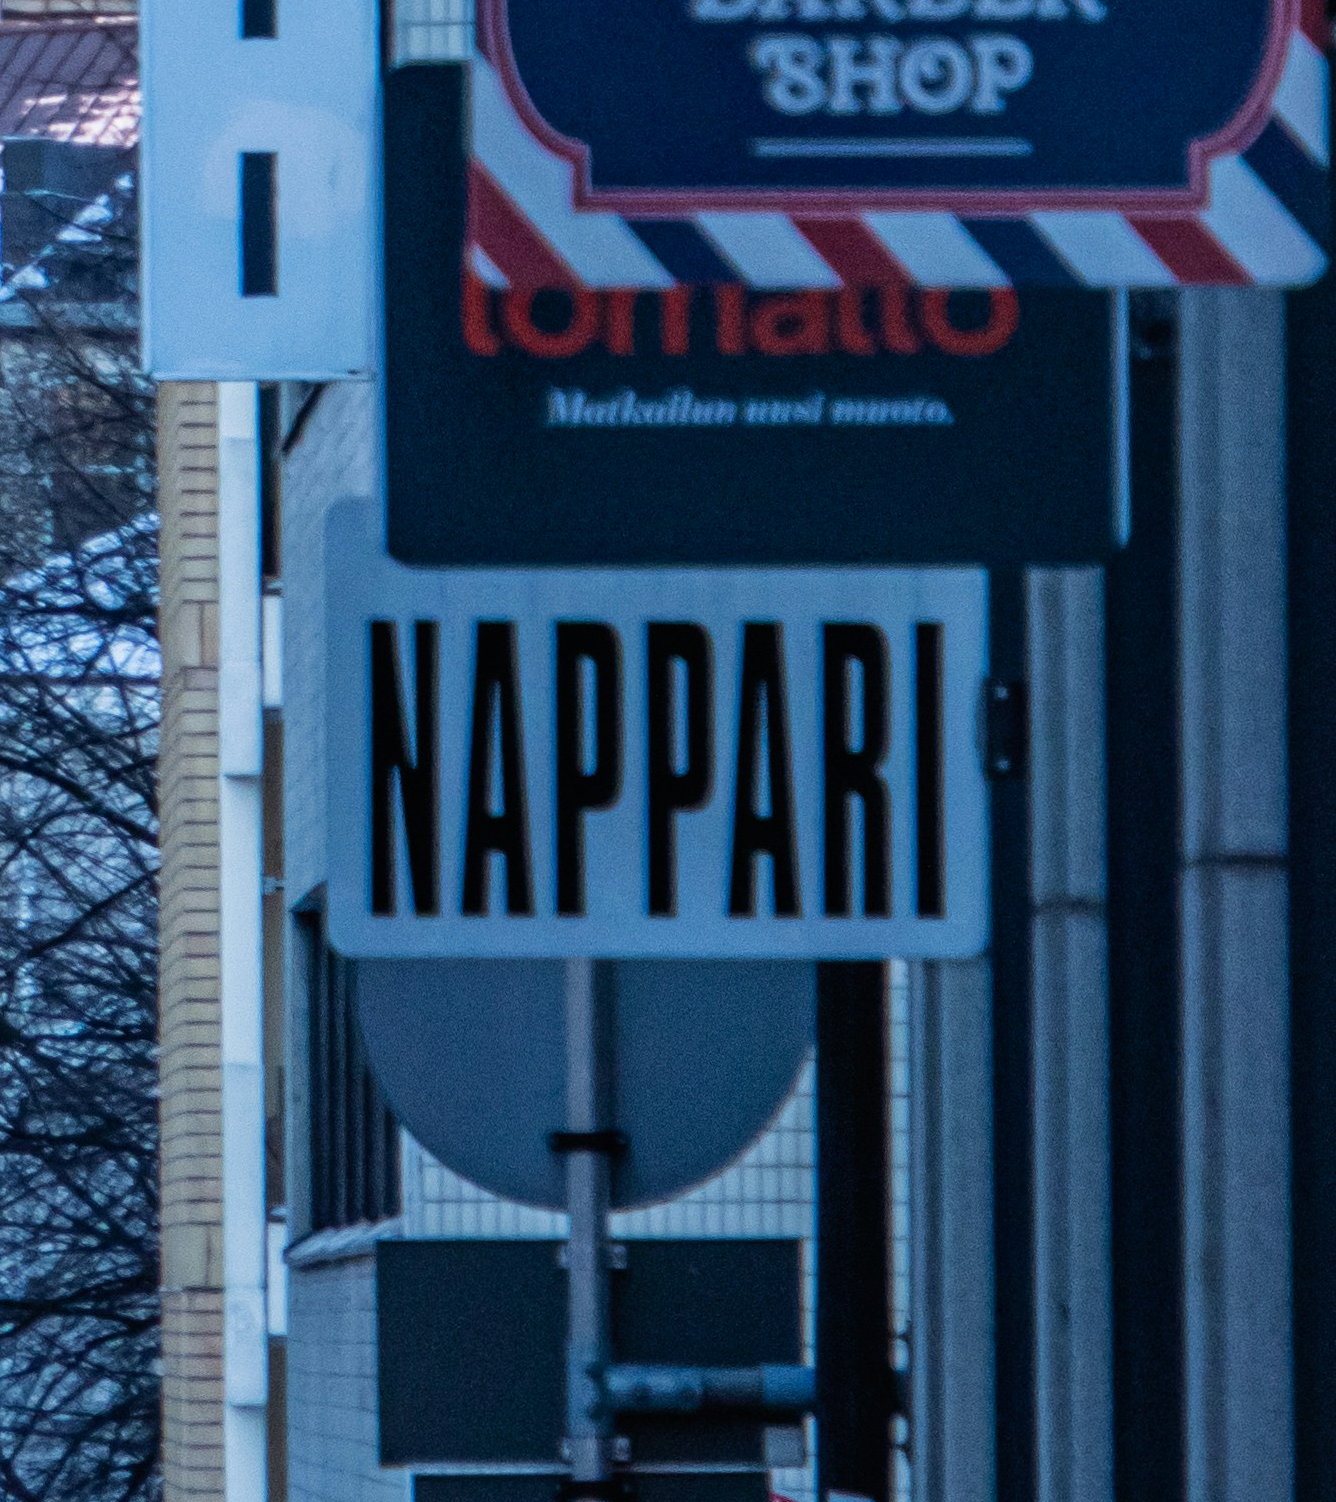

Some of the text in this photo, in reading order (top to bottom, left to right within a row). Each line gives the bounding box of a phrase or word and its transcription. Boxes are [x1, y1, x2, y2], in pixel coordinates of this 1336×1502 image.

[749, 33, 1034, 116] SHOP
[546, 386, 736, 427] Matkailun
[742, 390, 826, 426] uusi
[368, 619, 947, 919] NAPPARI
